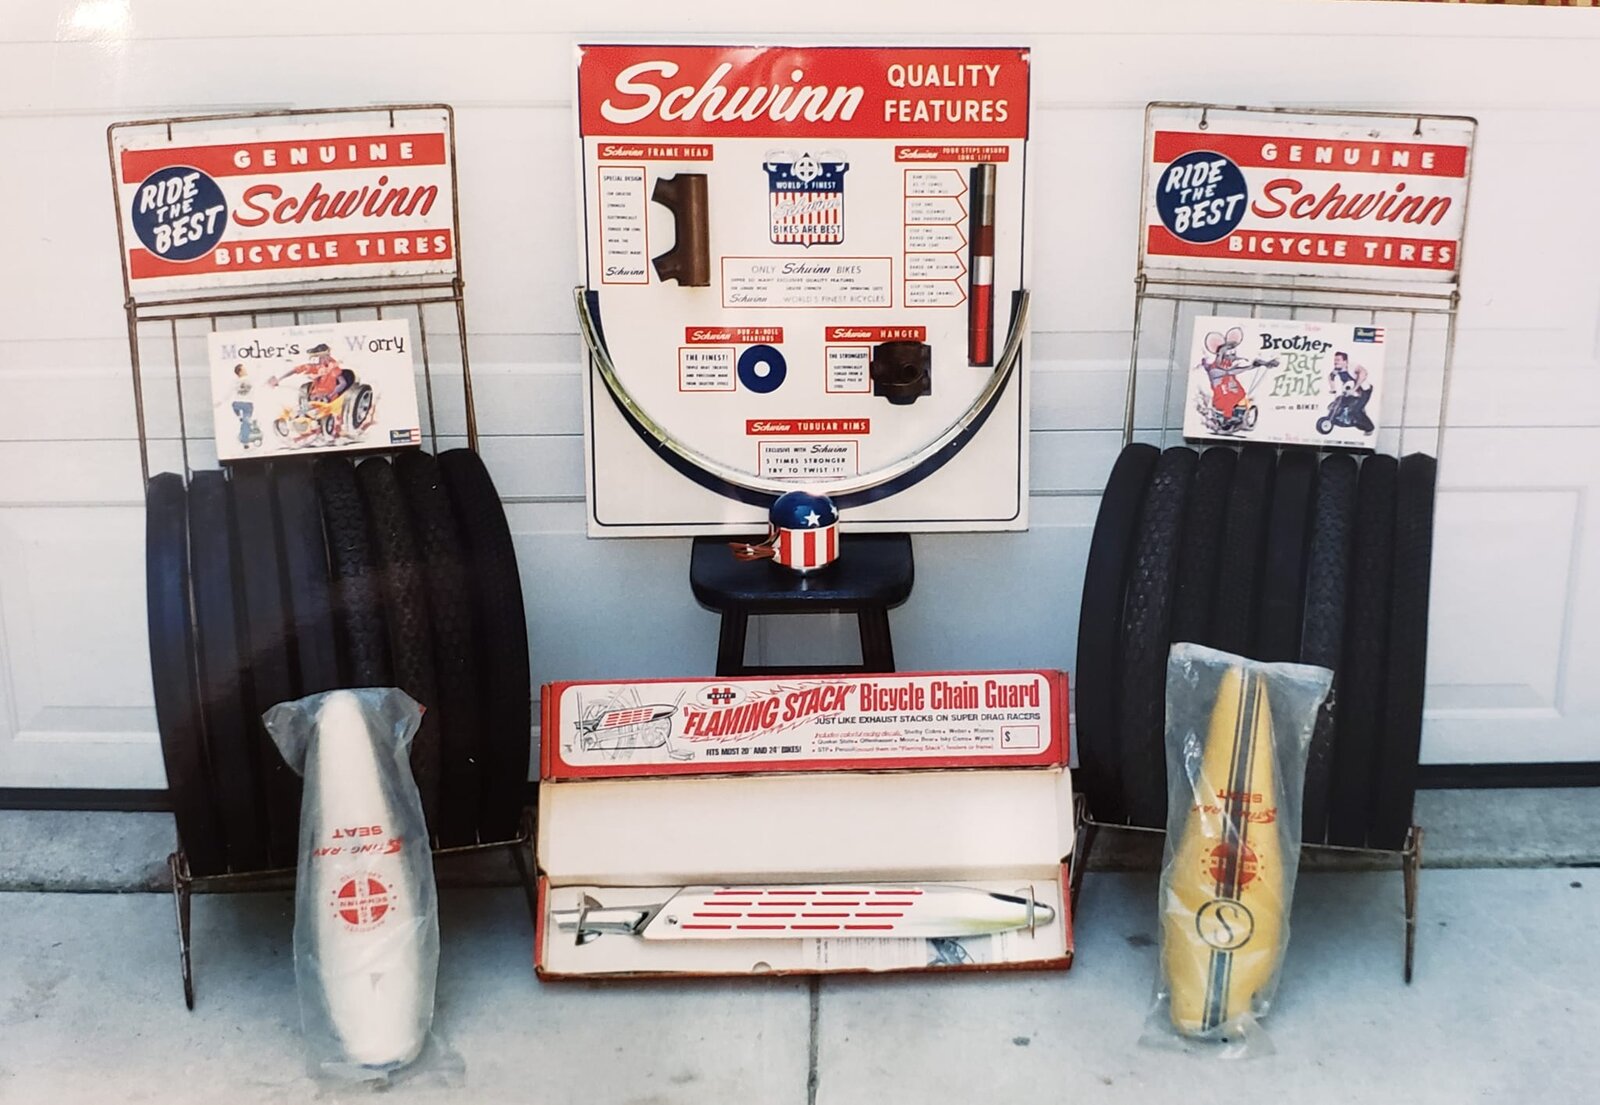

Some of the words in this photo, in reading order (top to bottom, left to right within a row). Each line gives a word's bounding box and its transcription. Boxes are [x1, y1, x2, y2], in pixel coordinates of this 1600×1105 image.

[887, 64, 1001, 88] QUALITY
[600, 59, 864, 124] Schwinn
[884, 99, 1008, 123] FEATURES
[233, 142, 414, 169] GENUINE
[602, 145, 644, 157] Schwinn
[647, 147, 680, 157] FRAME
[683, 148, 709, 157] HEAD
[1260, 143, 1435, 170] GENUINE
[775, 181, 809, 189] WORLD'S
[811, 181, 837, 189] FINEST
[1165, 160, 1226, 192] RIDE
[140, 172, 200, 214] RIDE
[232, 175, 438, 227] Schwinn
[1180, 184, 1216, 205] THE
[1251, 178, 1452, 226] Schwinn
[157, 198, 193, 224] THE
[1174, 193, 1244, 234] BEST
[154, 205, 224, 254] BEST
[772, 225, 800, 234] BIKES
[802, 225, 817, 234] ARE
[820, 225, 841, 234] BEST
[214, 240, 338, 265] BICYCLE
[356, 235, 447, 257] TIRES
[1228, 235, 1347, 257] BICYCLE
[1364, 241, 1451, 263] TIRES
[606, 267, 645, 277] Schwinn
[751, 265, 776, 274] ONLY
[781, 262, 831, 275] Schwinn
[836, 265, 862, 274] BIKES
[729, 293, 768, 304] Schwinn
[821, 295, 846, 303] FINEST
[849, 295, 885, 303] BICYCLES
[691, 330, 732, 341] Schwinn
[832, 328, 872, 339] Schwinn
[880, 330, 920, 338] HANGER
[1260, 333, 1333, 353] Brother
[221, 340, 300, 360] Mother's
[1280, 352, 1324, 374] Rat
[1269, 373, 1322, 397] Fink
[751, 421, 792, 432] Schwinn
[797, 422, 838, 431] TUBULAR
[843, 422, 866, 430] RIMS
[810, 444, 848, 454] Schwinn
[860, 682, 924, 712] Bicycle
[930, 681, 979, 710] Chain
[985, 679, 1040, 709] Guard
[814, 717, 837, 725] JUST
[838, 716, 857, 724] LIKE
[858, 716, 898, 724] EXHAUST
[899, 714, 934, 723] STACKS
[936, 714, 948, 722] ON
[951, 713, 979, 722] SUPER
[980, 713, 1004, 721] DRAG
[1006, 712, 1041, 720] RACERS
[1004, 731, 1011, 742] $
[706, 748, 719, 756] FITS
[721, 747, 740, 755] MOST
[753, 746, 767, 754] AND
[781, 745, 802, 753] BIKES!
[332, 825, 383, 839] SEAT
